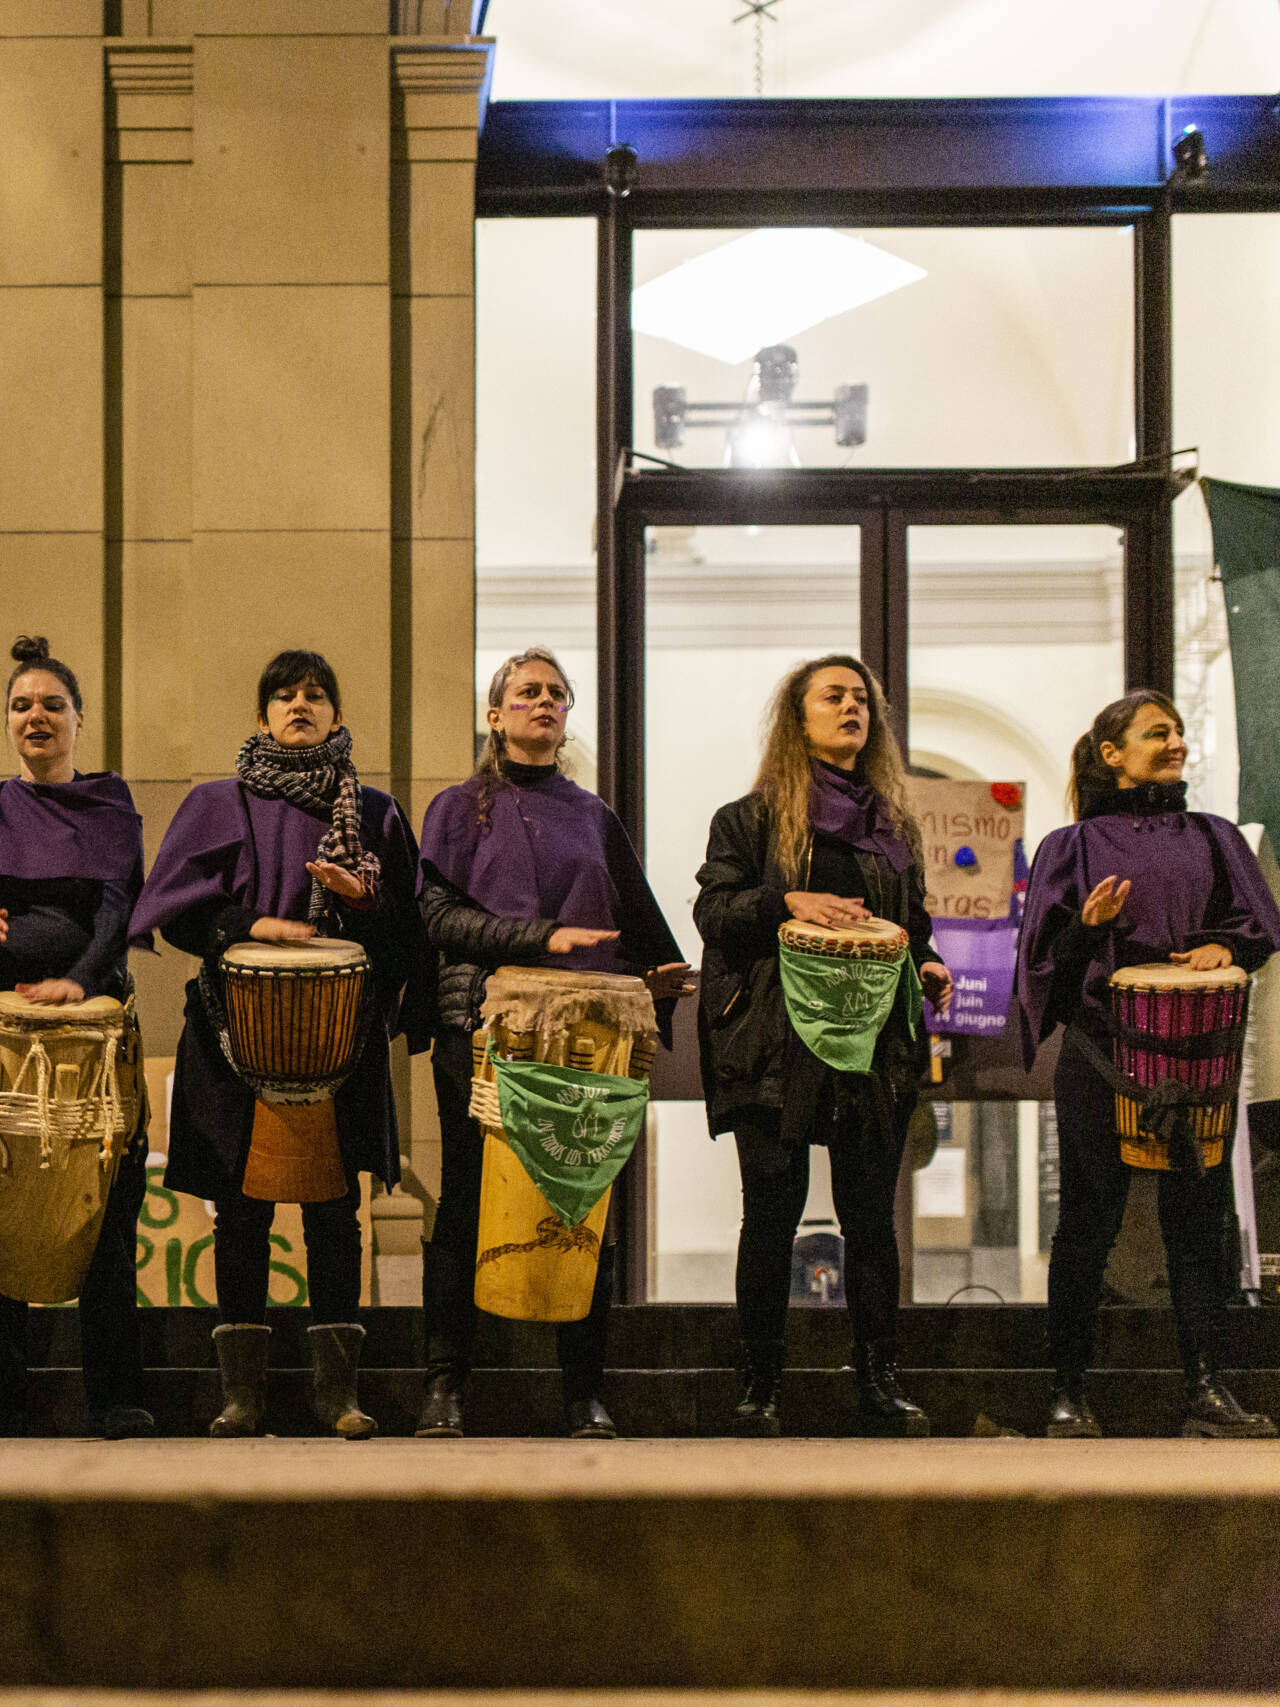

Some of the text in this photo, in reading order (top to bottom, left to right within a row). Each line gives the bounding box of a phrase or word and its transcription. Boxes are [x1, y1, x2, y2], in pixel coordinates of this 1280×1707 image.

[956, 976, 987, 991] Juni
[956, 1012, 1006, 1029] giugno
[565, 1149, 584, 1166] LOS
